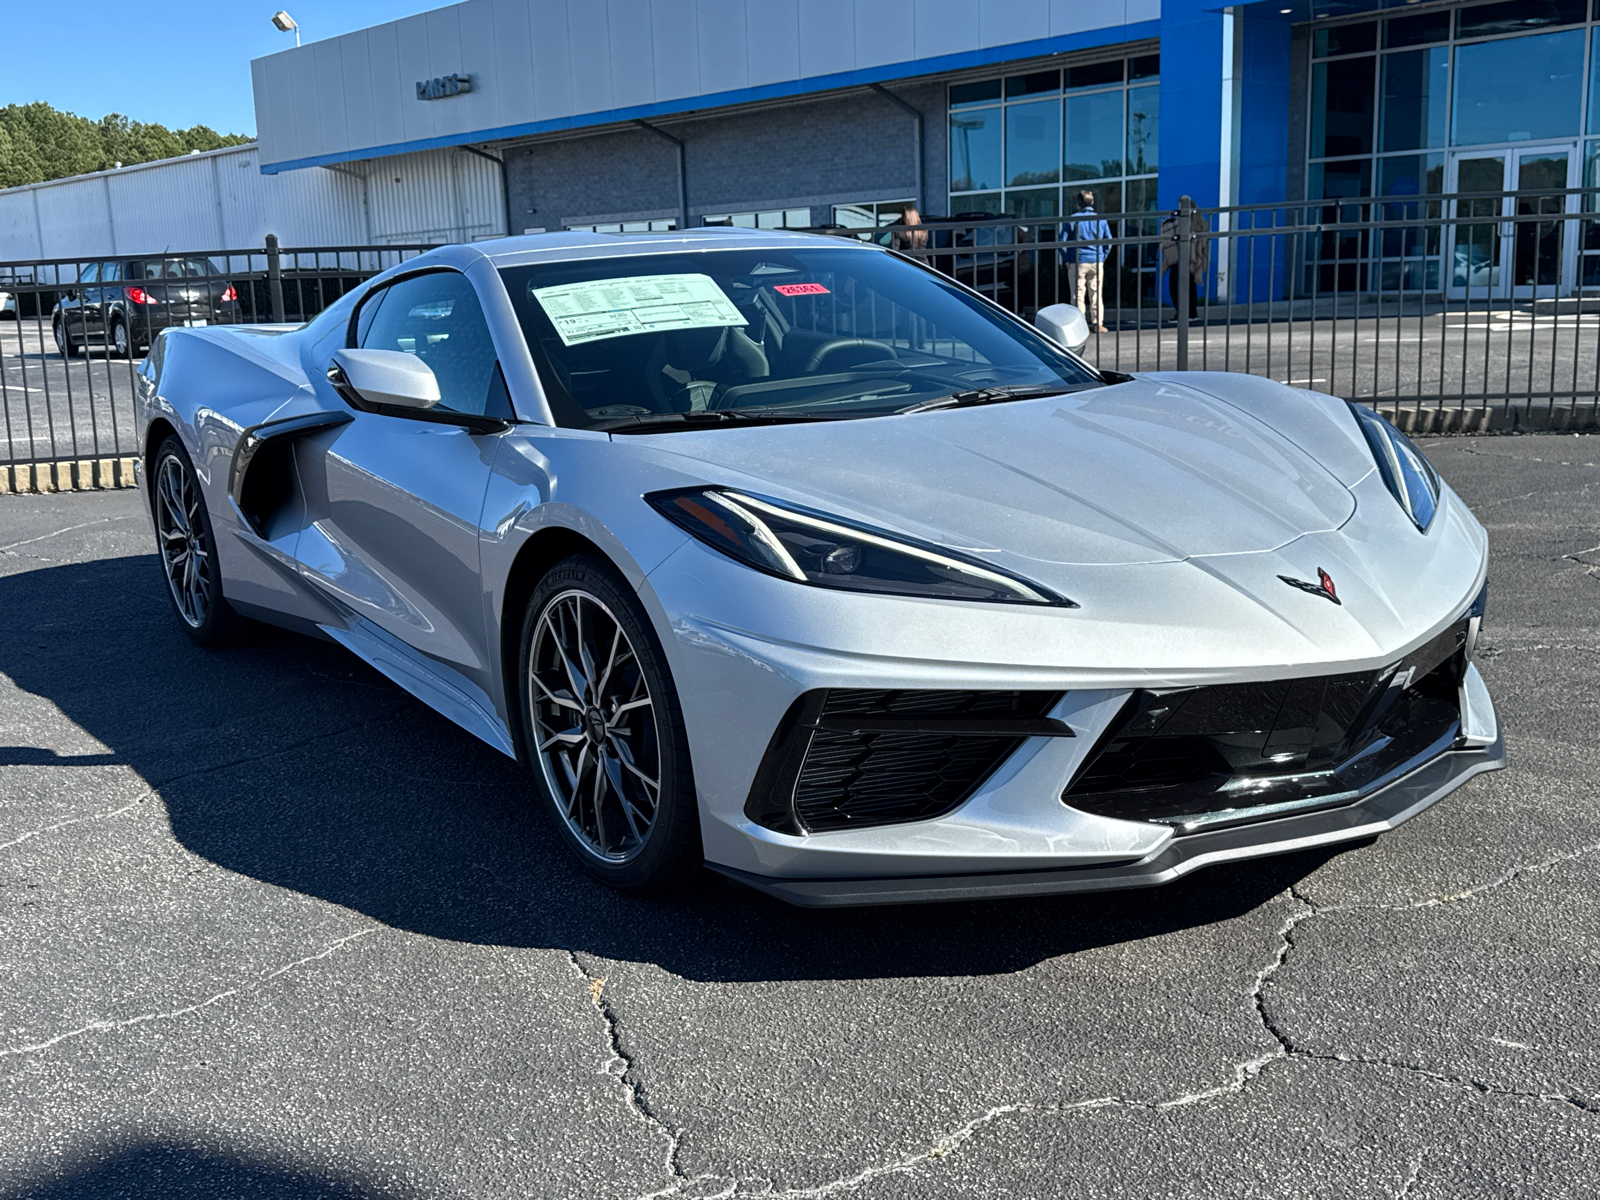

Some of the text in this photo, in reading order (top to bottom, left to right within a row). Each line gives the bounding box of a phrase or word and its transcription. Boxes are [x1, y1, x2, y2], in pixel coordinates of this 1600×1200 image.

[416, 73, 462, 100] PARTS
[782, 285, 819, 294] 26361
[548, 570, 584, 581] MICHELIN
[588, 576, 600, 587] PILOT
[600, 585, 615, 600] SPORT
[615, 601, 623, 612] ALL
[622, 613, 640, 640] SEASON
